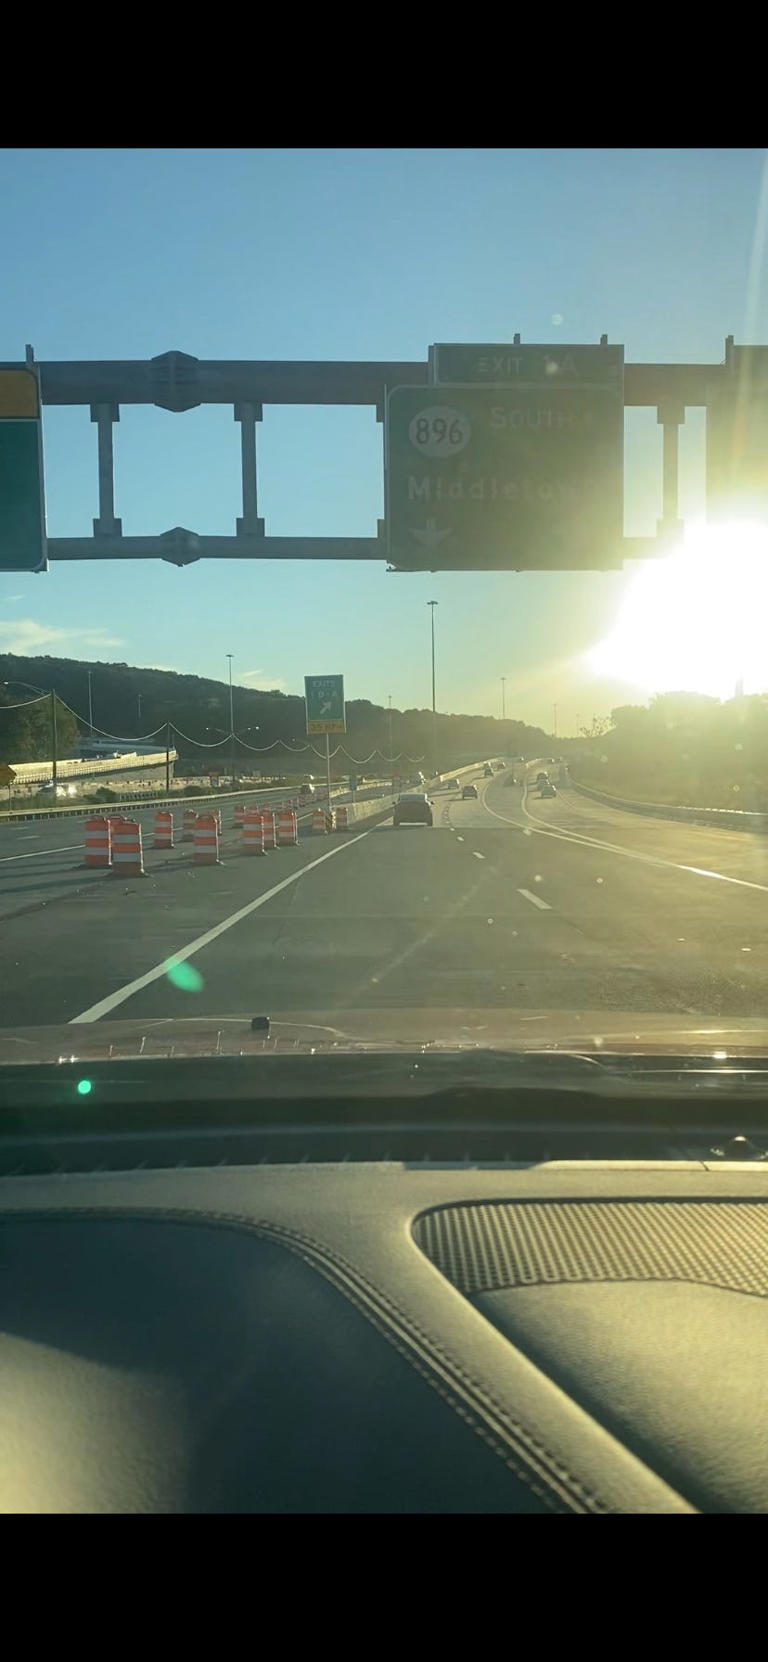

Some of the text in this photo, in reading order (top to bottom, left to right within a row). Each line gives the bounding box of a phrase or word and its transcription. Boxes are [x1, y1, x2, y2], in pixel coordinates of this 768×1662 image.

[477, 356, 523, 374] EXIT
[489, 405, 578, 430] SOUTH
[415, 418, 463, 445] 896
